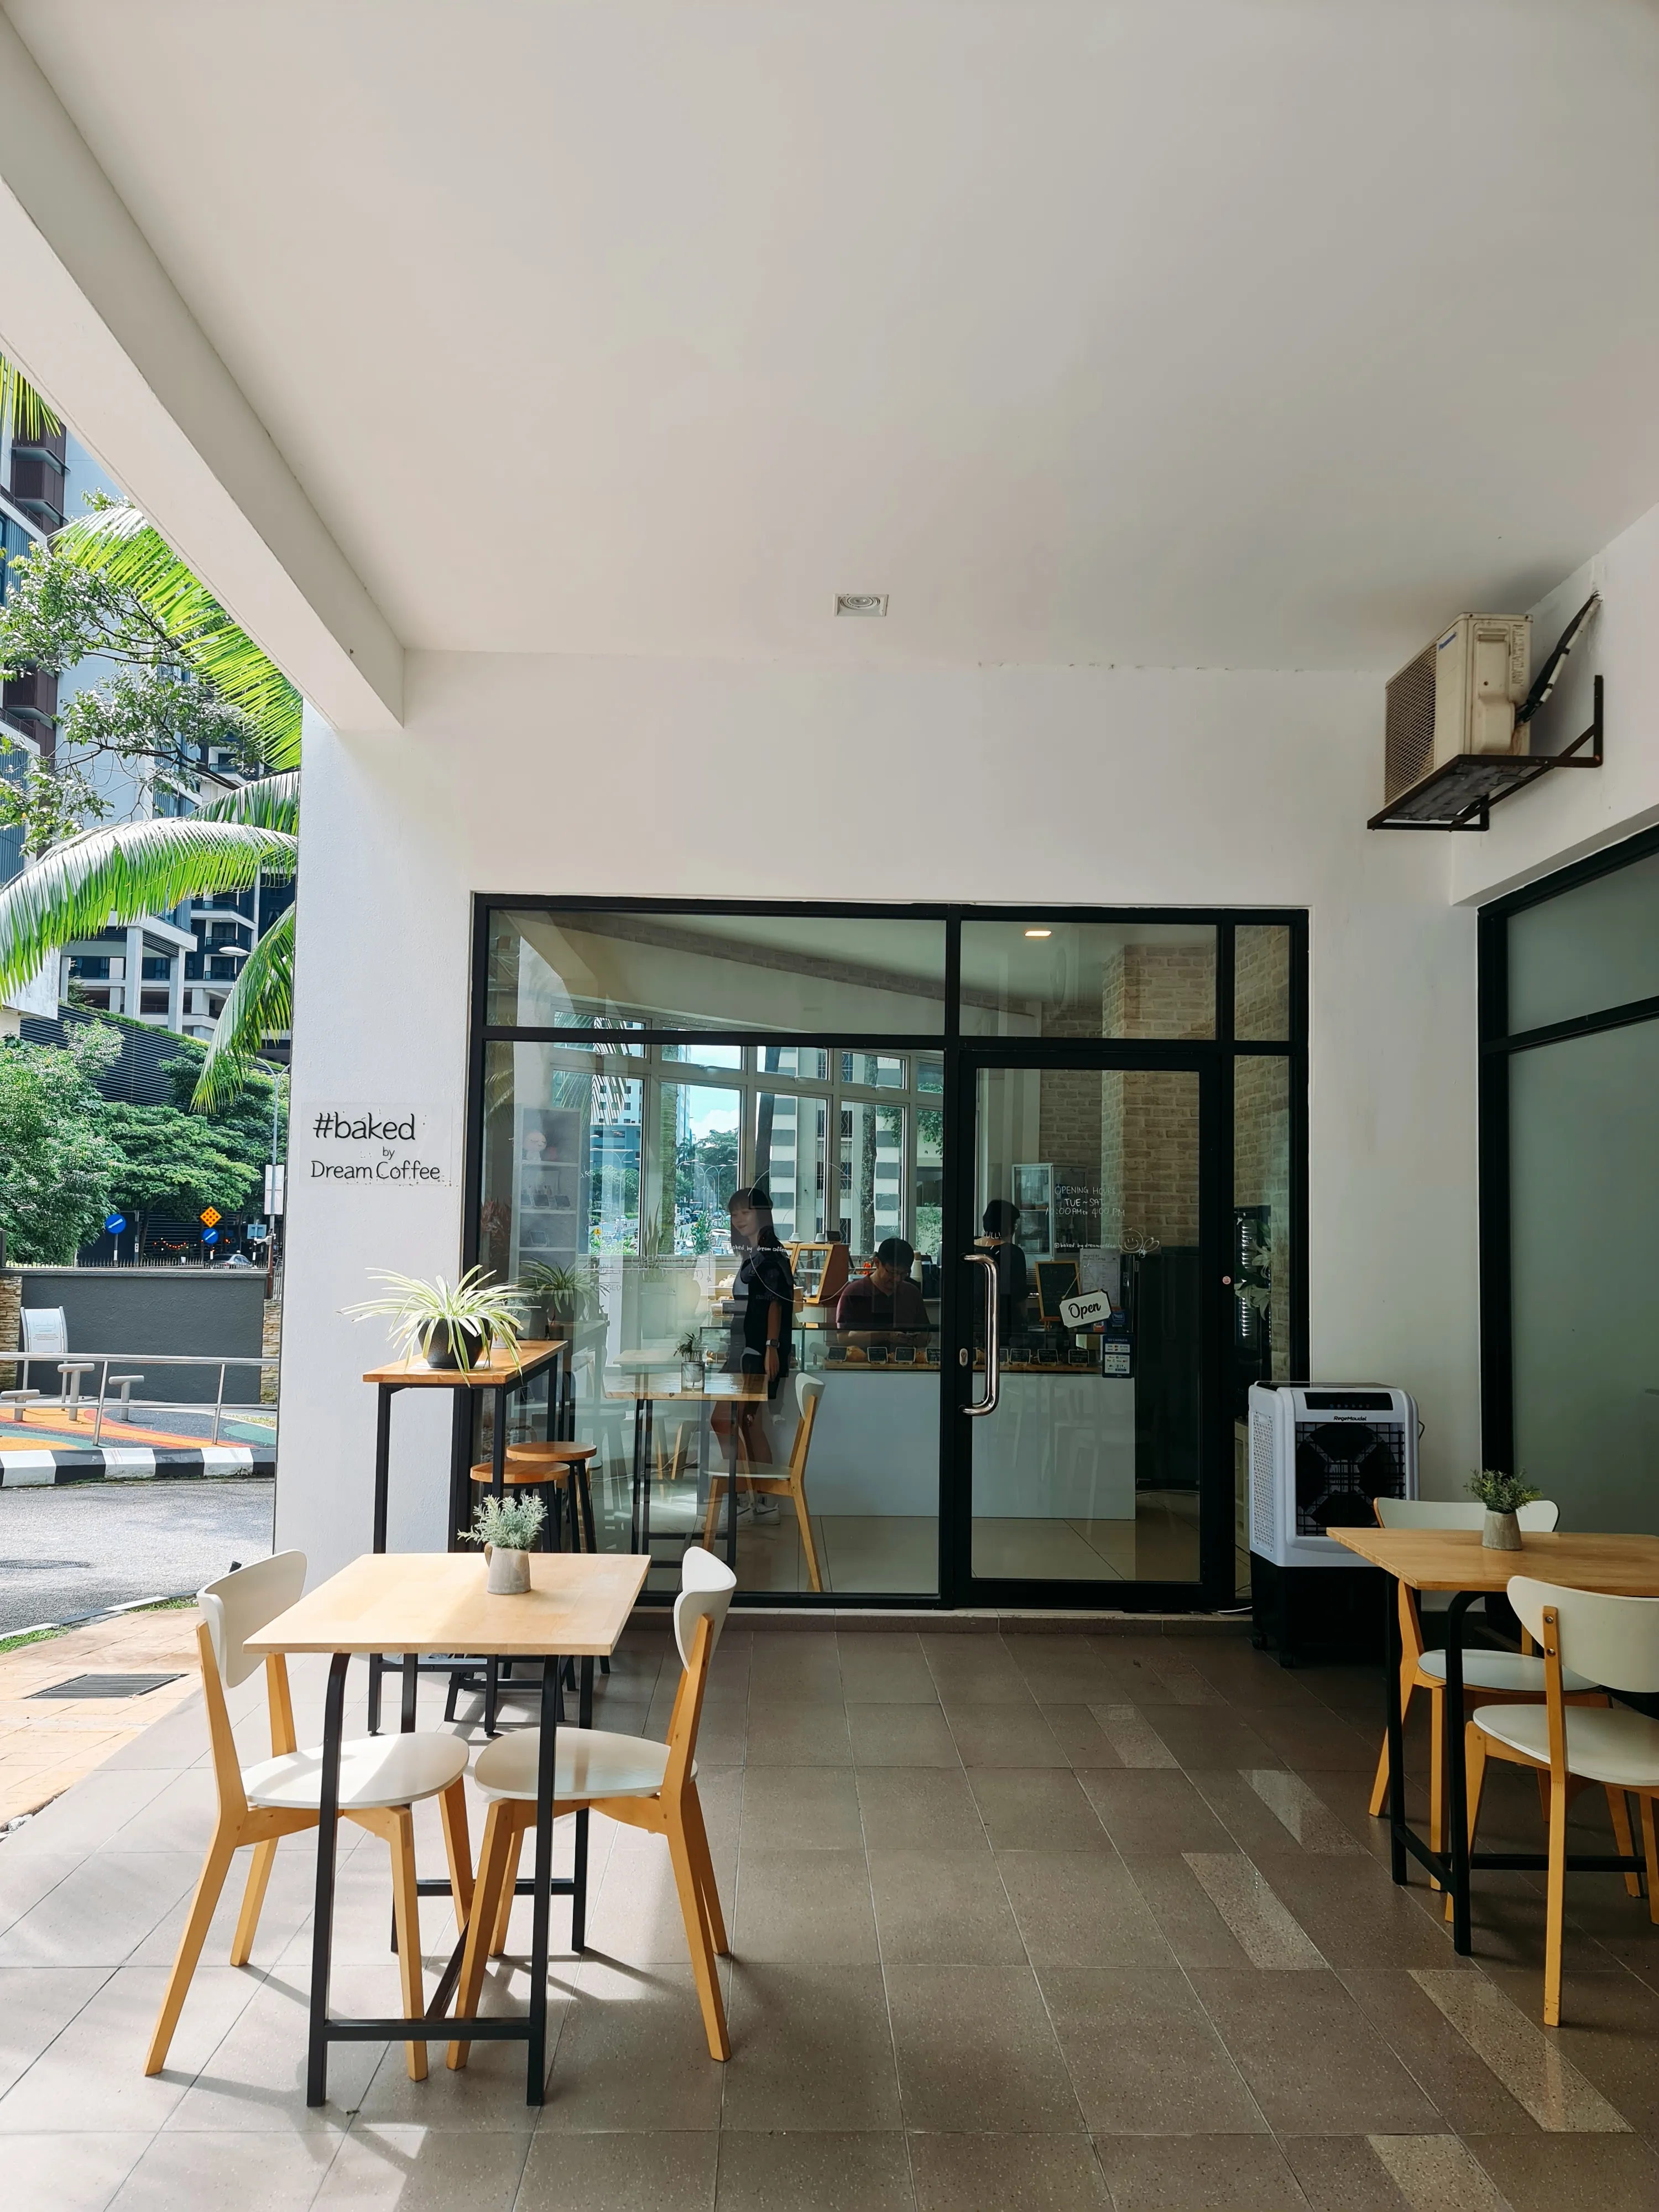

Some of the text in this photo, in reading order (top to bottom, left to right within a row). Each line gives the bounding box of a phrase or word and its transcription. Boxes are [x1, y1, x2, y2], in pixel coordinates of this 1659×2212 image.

[312, 1112, 415, 1140] #baked
[382, 1146, 395, 1160] by
[311, 1160, 440, 1179] Dream Coffee
[1055, 1186, 1089, 1195] OPENING
[1068, 1302, 1102, 1320] Open
